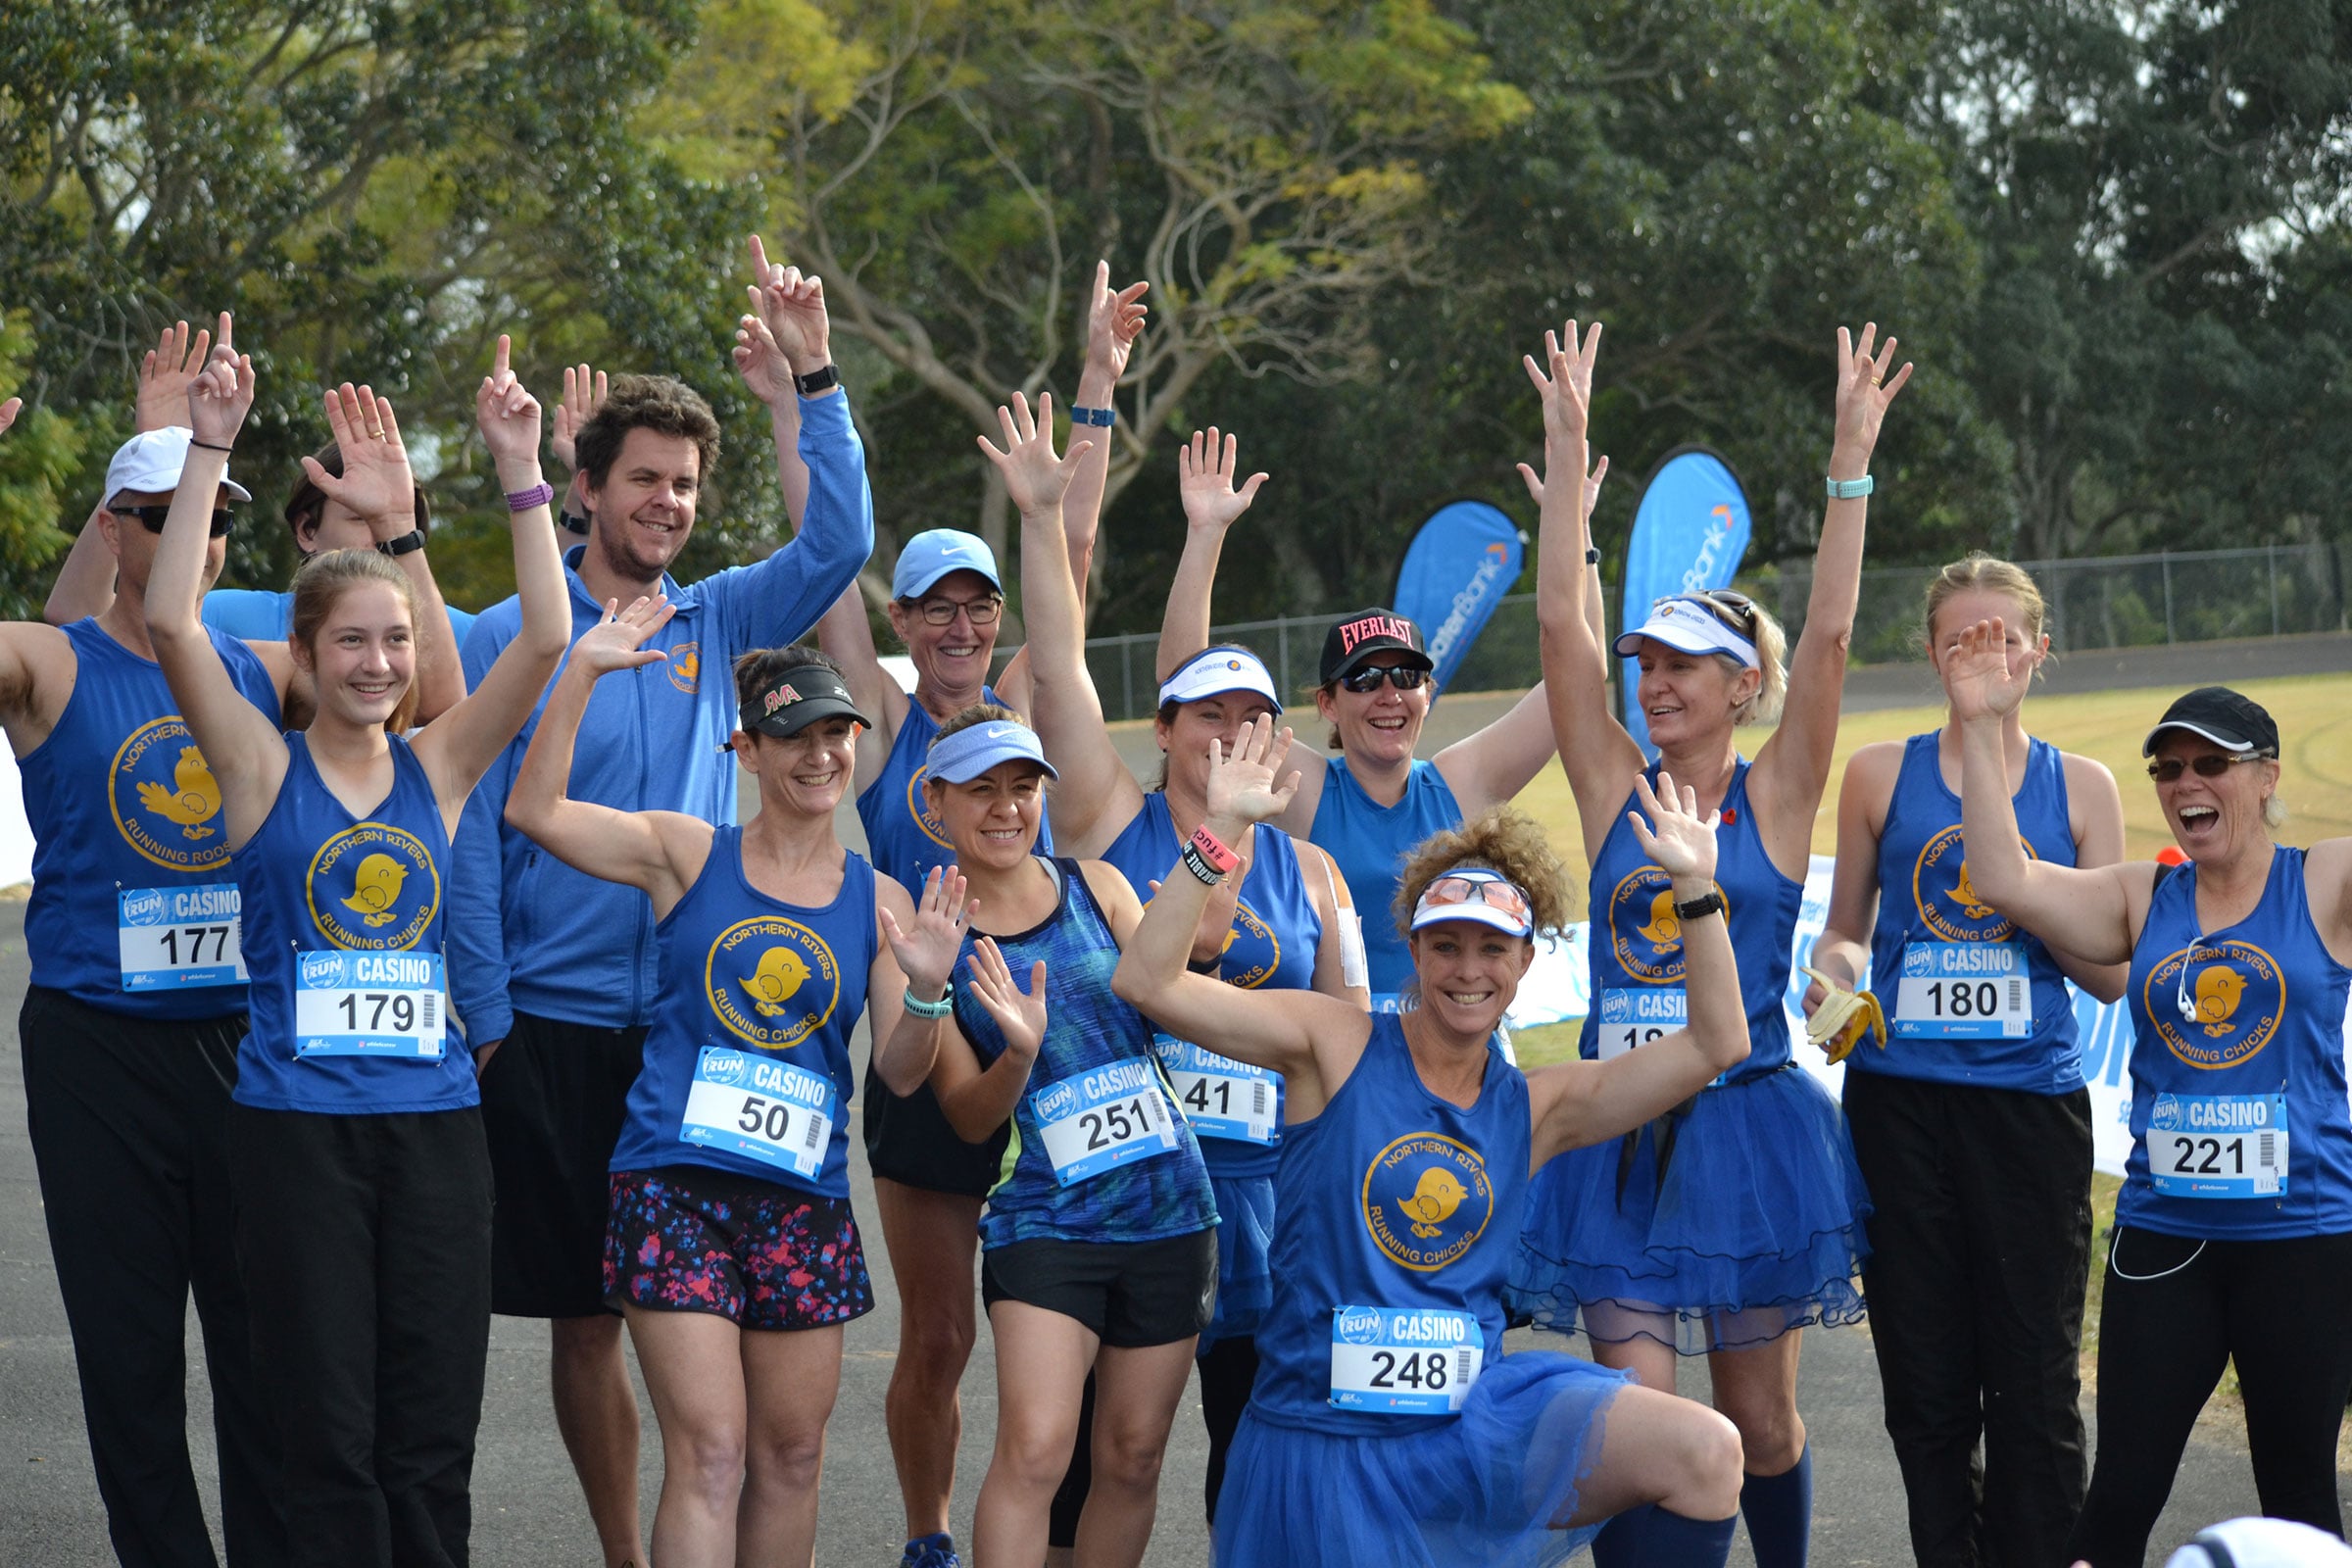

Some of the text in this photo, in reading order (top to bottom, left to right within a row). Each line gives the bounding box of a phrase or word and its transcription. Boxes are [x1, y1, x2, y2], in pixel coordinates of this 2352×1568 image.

[1339, 615, 1415, 656] EVERLAST
[125, 818, 188, 862] RUNNING
[318, 831, 427, 875] NORTHERN RIVERS
[127, 895, 162, 917] RUN
[175, 890, 241, 917] CASINO
[1924, 902, 1980, 941] RUNNING
[320, 905, 430, 950] RUNNING CHICKS
[1233, 908, 1266, 939] IVERS
[161, 926, 229, 964] 177
[722, 923, 833, 980] NORTHERN RIVERS
[1618, 937, 1663, 976] RUNNING
[1906, 951, 1931, 966] RUN
[1942, 948, 2013, 972] CASINO
[308, 957, 342, 979] RUN
[357, 956, 431, 984] CASINO
[2155, 948, 2273, 986] NORTHERN RIVERS
[339, 993, 415, 1032] 179
[714, 988, 819, 1041] RUNNING CHICKS
[1927, 982, 1997, 1016] 180
[1155, 1041, 1183, 1056] UN
[2162, 1015, 2274, 1061] RUNNING CHICKS
[707, 1058, 743, 1073] RUN
[1084, 1062, 1148, 1100] CASINO
[755, 1063, 826, 1106] CASINO
[1042, 1086, 1074, 1113] RUN
[1184, 1078, 1230, 1114] 41
[738, 1096, 790, 1141] 50
[1079, 1099, 1150, 1152] 251
[2155, 1102, 2178, 1118] RUN
[2189, 1102, 2267, 1126] CASINO
[1384, 1141, 1453, 1168] NORTHERN
[2174, 1137, 2243, 1174] 221
[1370, 1205, 1474, 1263] RUNNING CHICKS
[1345, 1315, 1379, 1333] RUN
[1393, 1314, 1466, 1342] CASINO
[1369, 1350, 1447, 1390] 248
